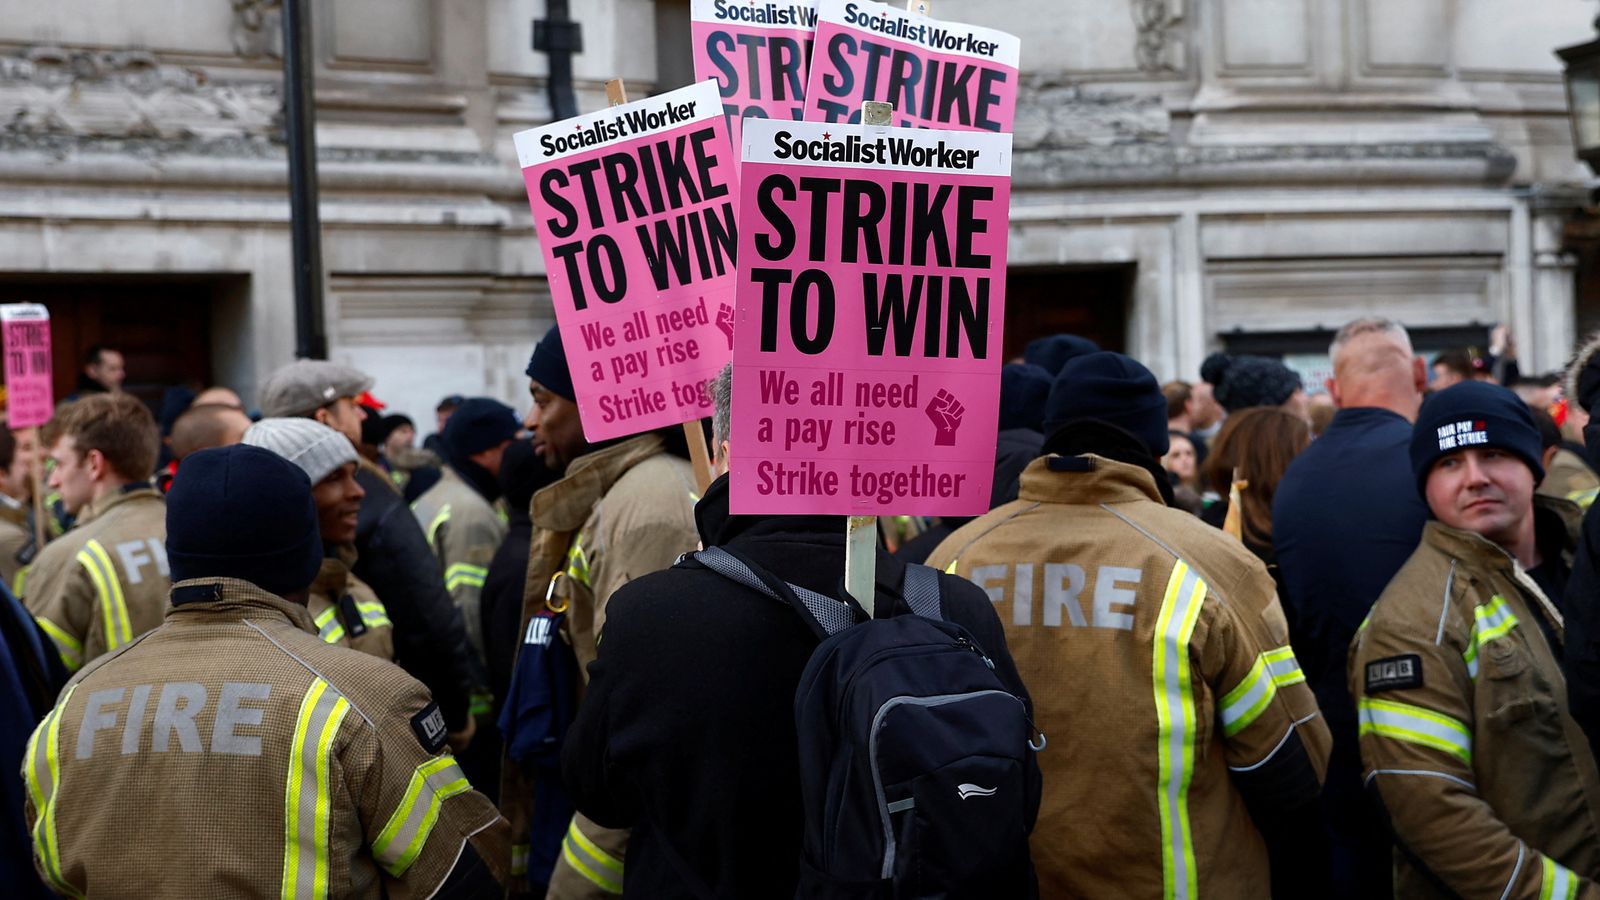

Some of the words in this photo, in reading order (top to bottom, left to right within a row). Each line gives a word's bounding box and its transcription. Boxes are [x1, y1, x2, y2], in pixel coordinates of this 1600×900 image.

[823, 33, 1006, 132] STRIKE
[540, 127, 729, 238] STRIKE
[755, 174, 993, 269] STRIKE
[552, 234, 628, 311] TO
[635, 202, 738, 291] WIN
[580, 322, 616, 351] We
[623, 311, 650, 342] all
[656, 297, 709, 335] need
[751, 268, 836, 354] TO
[862, 272, 990, 359] WIN
[590, 361, 605, 382] a
[611, 350, 648, 384] pay
[656, 337, 700, 367] rise
[599, 387, 667, 423] Strike
[760, 370, 799, 405] We
[810, 372, 844, 406] all
[855, 375, 919, 408] need
[757, 417, 773, 442] a
[785, 418, 833, 451] pay
[844, 412, 896, 446] rise
[1456, 420, 1473, 434] PAY
[1456, 430, 1489, 446] STRIKE
[757, 460, 839, 495] Strike
[850, 464, 966, 505] together
[116, 538, 171, 585] FI
[971, 562, 1143, 631] FIRE
[75, 682, 271, 760] FIRE
